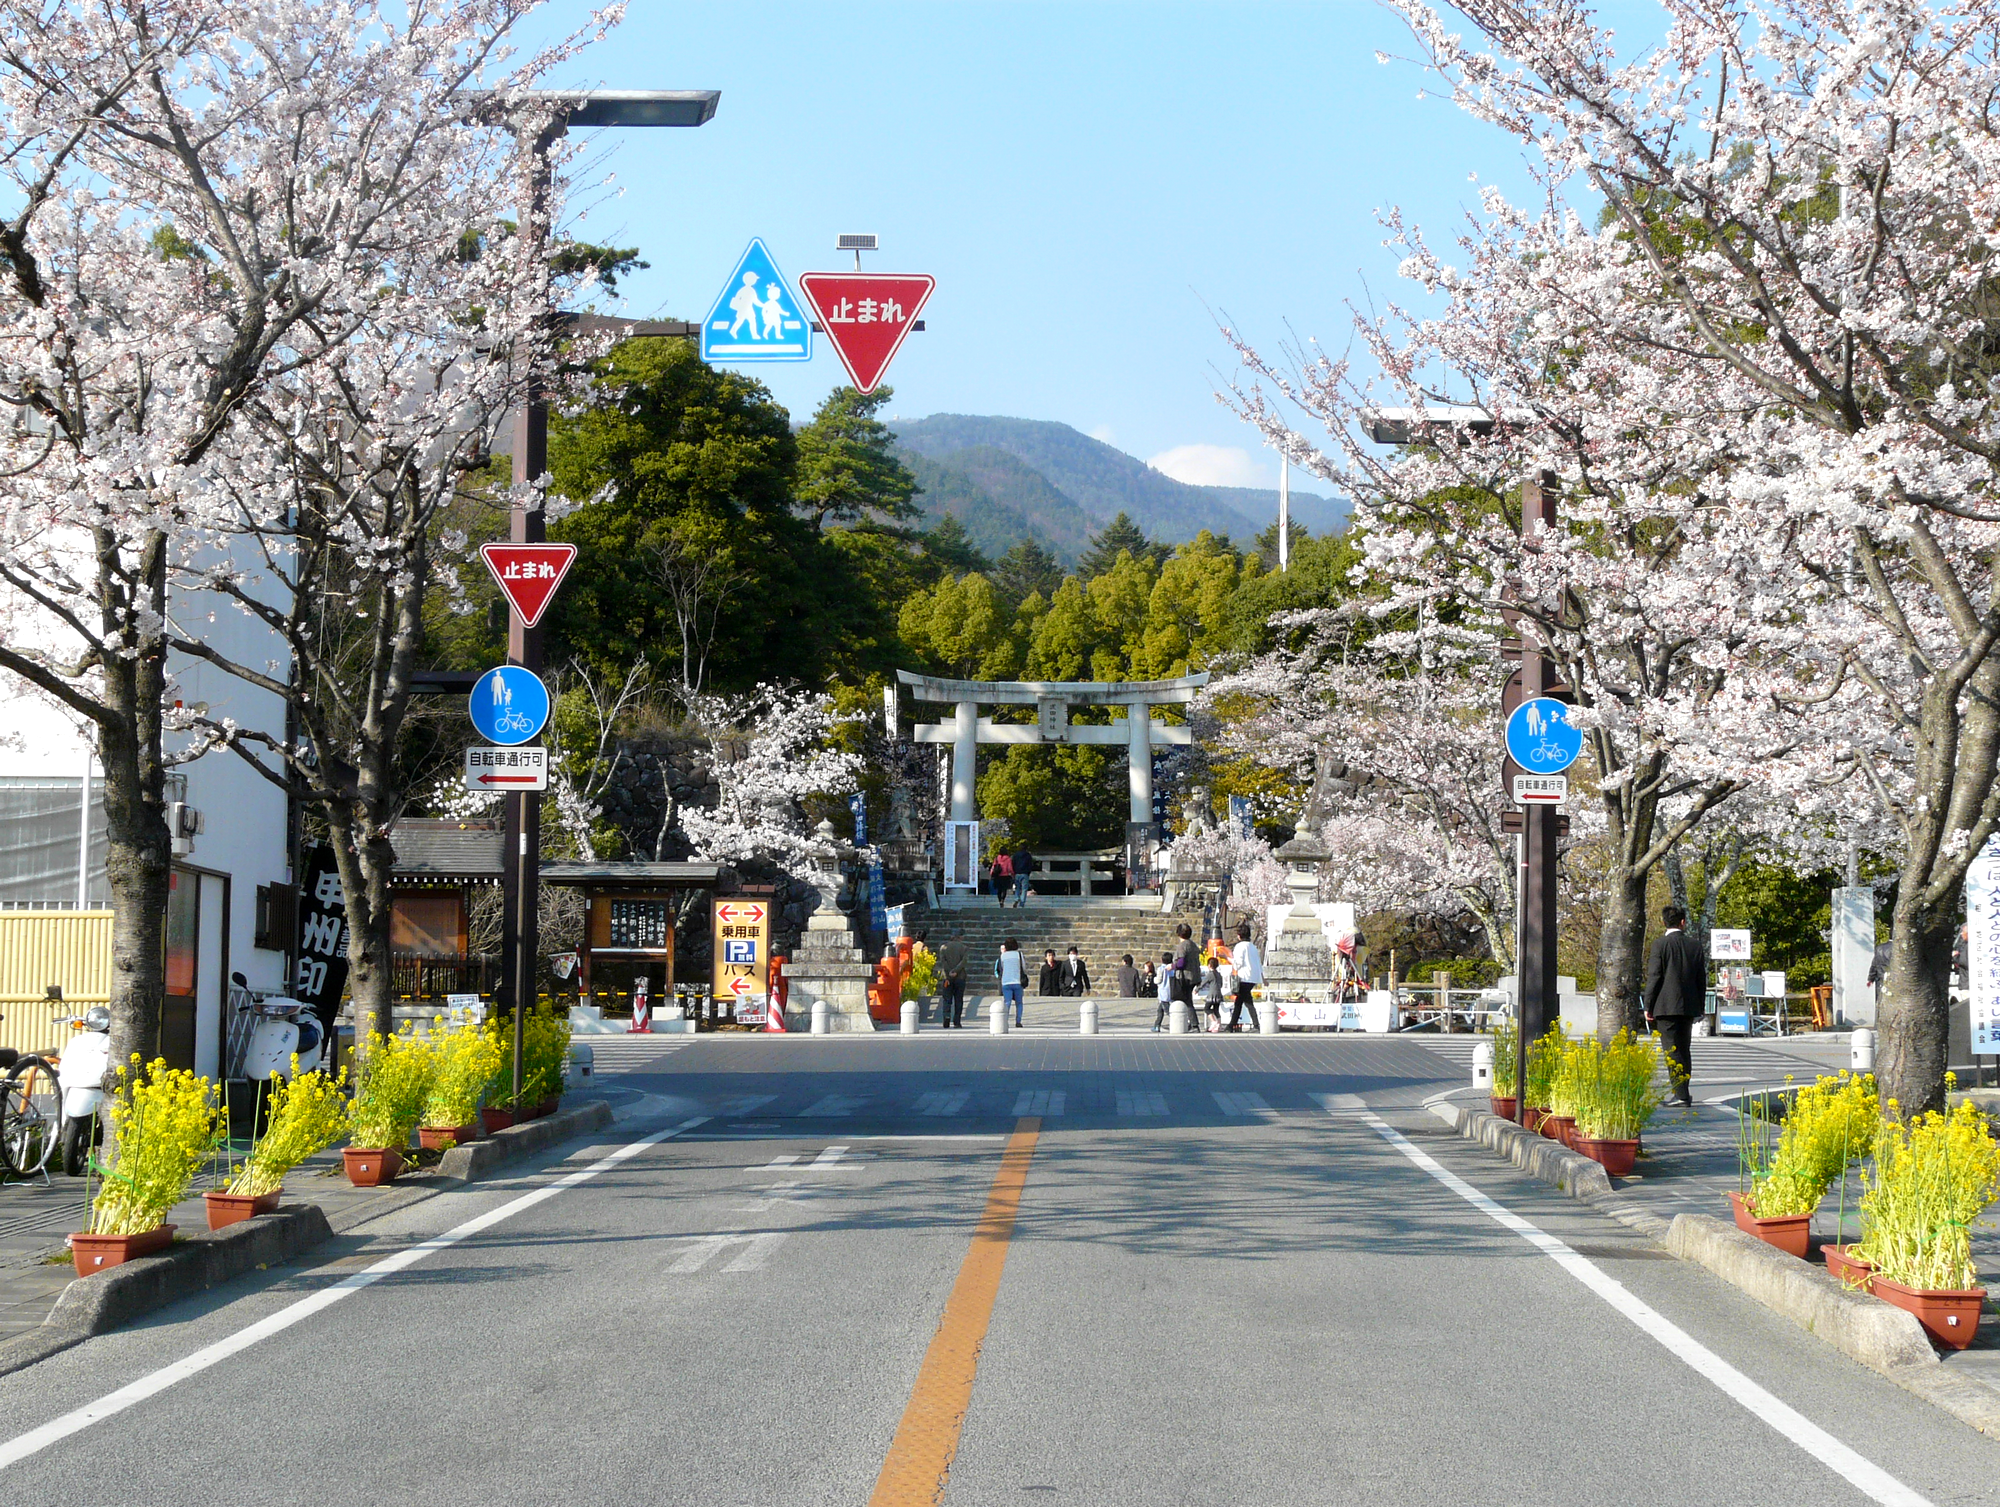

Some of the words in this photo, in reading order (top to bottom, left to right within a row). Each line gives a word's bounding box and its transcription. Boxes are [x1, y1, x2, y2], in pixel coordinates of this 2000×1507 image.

[829, 297, 906, 324] 止まれ
[503, 561, 556, 579] 止まれ
[470, 751, 543, 767] 自転車通行可
[1517, 780, 1564, 790] 自転車通行可
[721, 925, 760, 938] 乗用車
[730, 941, 749, 961] P
[724, 965, 756, 976] バス
